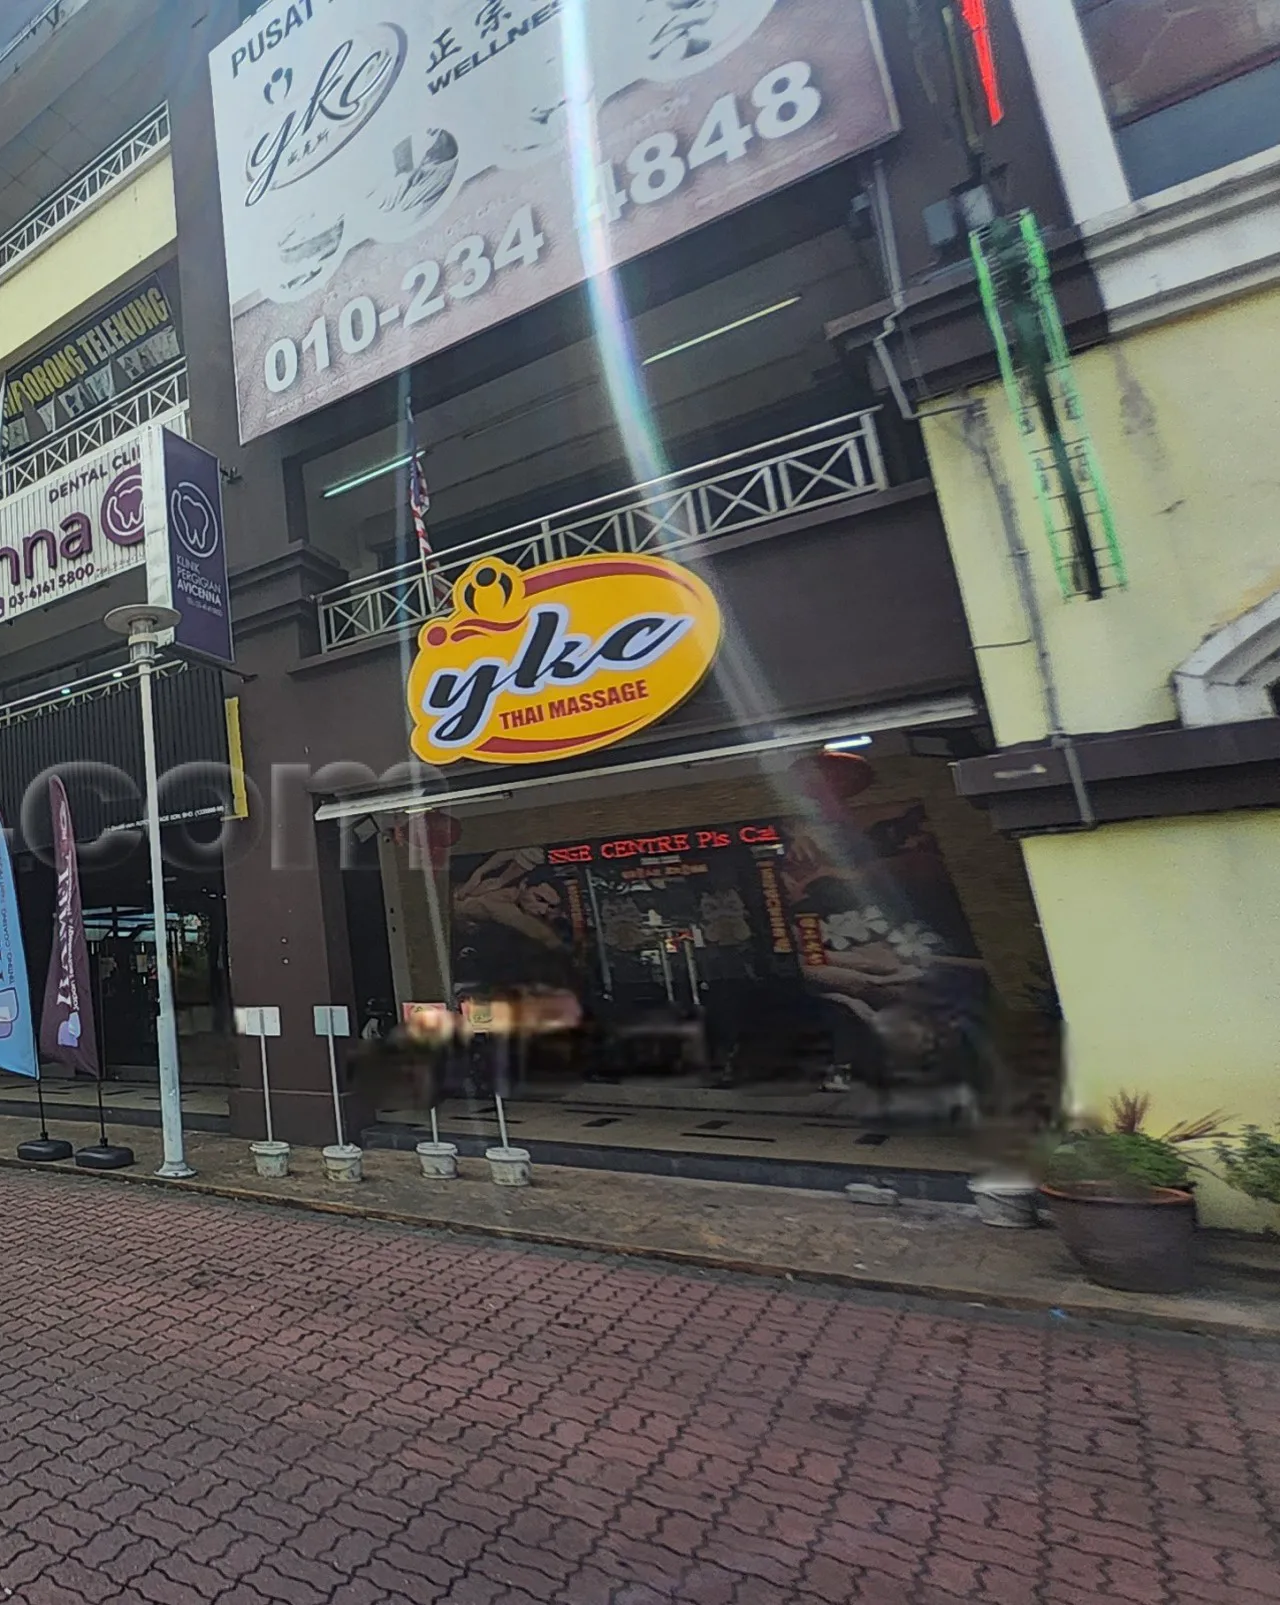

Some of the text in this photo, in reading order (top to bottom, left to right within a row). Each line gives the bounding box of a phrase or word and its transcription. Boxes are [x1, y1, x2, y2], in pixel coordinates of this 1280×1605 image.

[427, 0, 564, 95] WELLNE
[263, 205, 544, 395] 010-234
[76, 287, 169, 366] TELEKUNG
[49, 471, 108, 503] DENTAL
[58, 563, 95, 590] 5800
[176, 554, 201, 574] KLINIK
[177, 579, 222, 607] AVICENNA
[428, 611, 687, 741] ykc
[499, 679, 649, 730] THAI MASSAGE
[601, 832, 690, 860] CENTRE
